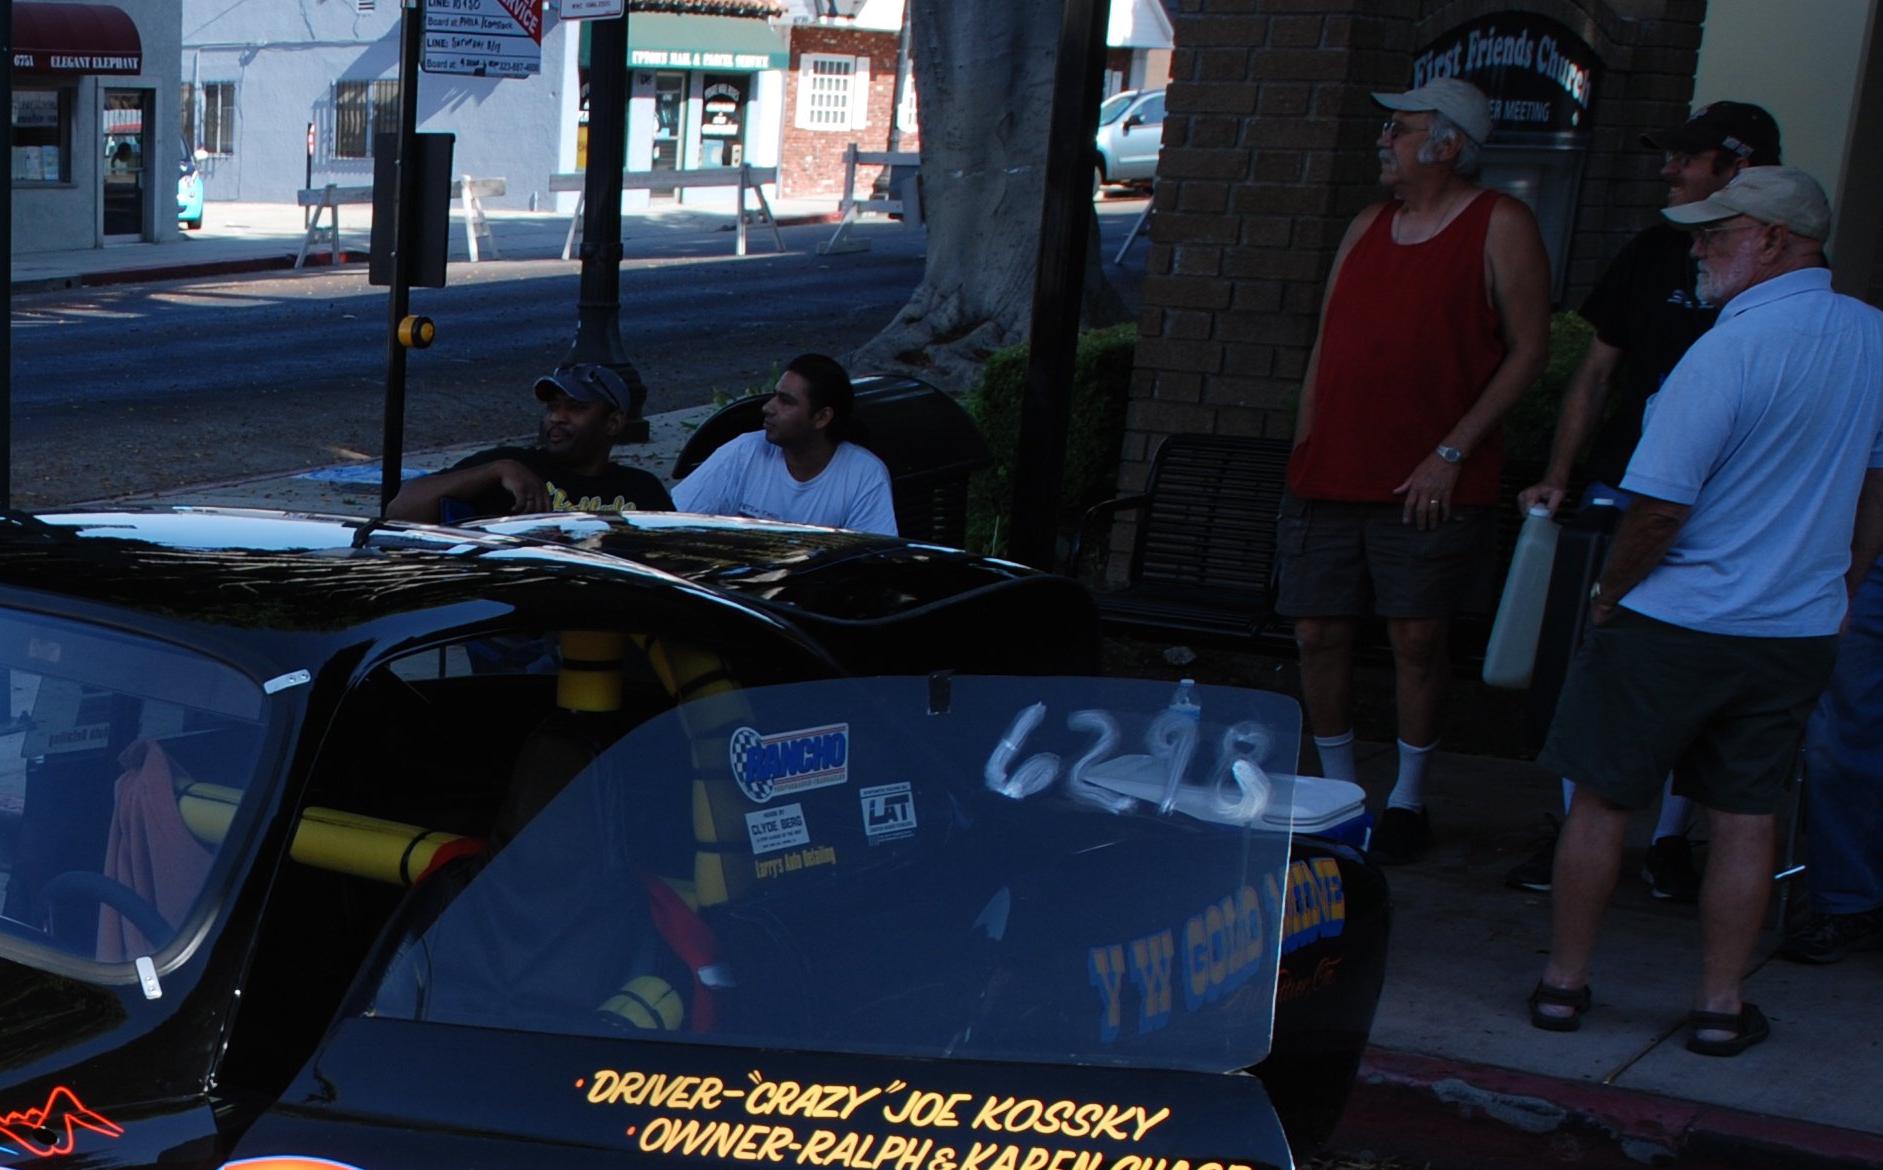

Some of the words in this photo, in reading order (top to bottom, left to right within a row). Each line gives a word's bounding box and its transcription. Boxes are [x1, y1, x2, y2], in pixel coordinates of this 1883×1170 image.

[50, 55, 91, 69] ELEGANT
[92, 57, 139, 70] ELEPHANT
[1414, 40, 1462, 89] First
[1465, 26, 1534, 71] Friends
[1536, 34, 1591, 109] Church
[1503, 101, 1550, 122] MEETING
[745, 732, 846, 784] RANCHO
[751, 820, 778, 837] CLYDE
[780, 815, 803, 831] BERG
[869, 793, 910, 827] LAT
[883, 1090, 972, 1127] JOE
[971, 1096, 1171, 1142] KOSSKY
